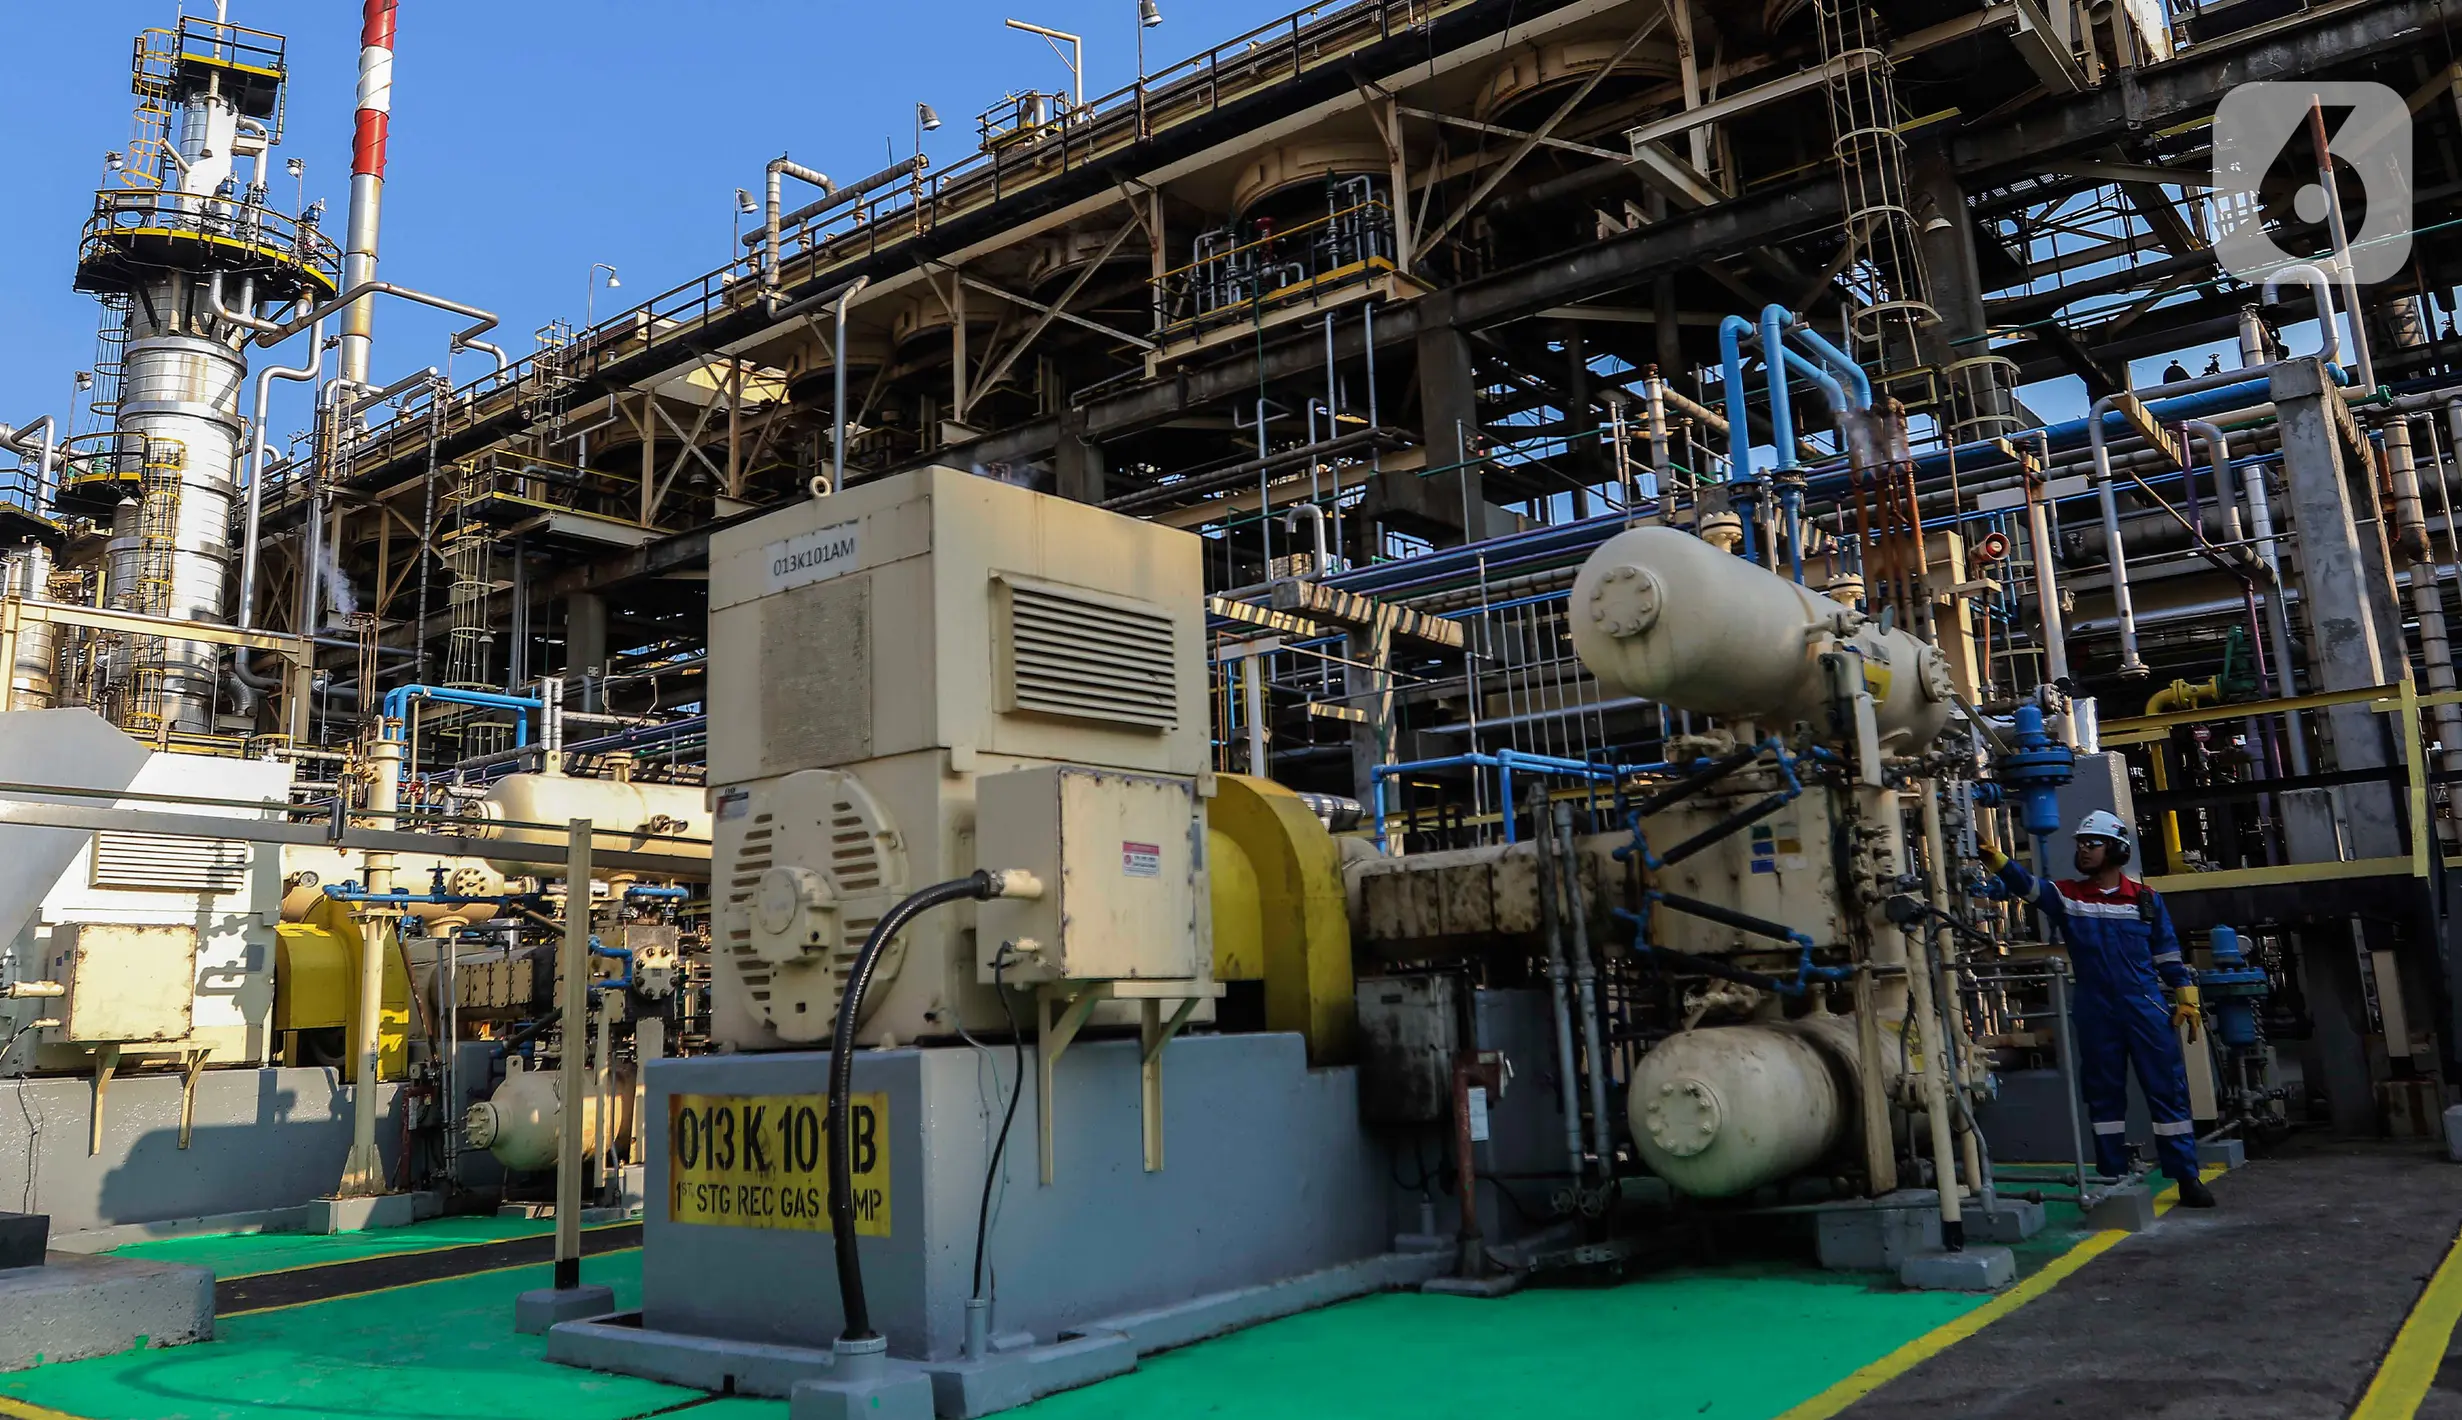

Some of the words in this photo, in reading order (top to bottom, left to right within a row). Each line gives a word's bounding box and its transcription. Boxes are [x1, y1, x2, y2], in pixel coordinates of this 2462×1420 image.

[773, 537, 854, 577] 013K101AM
[777, 1105, 831, 1173] 10
[697, 1183, 731, 1214] STG
[737, 1184, 774, 1217] REC
[781, 1187, 820, 1219] GAS
